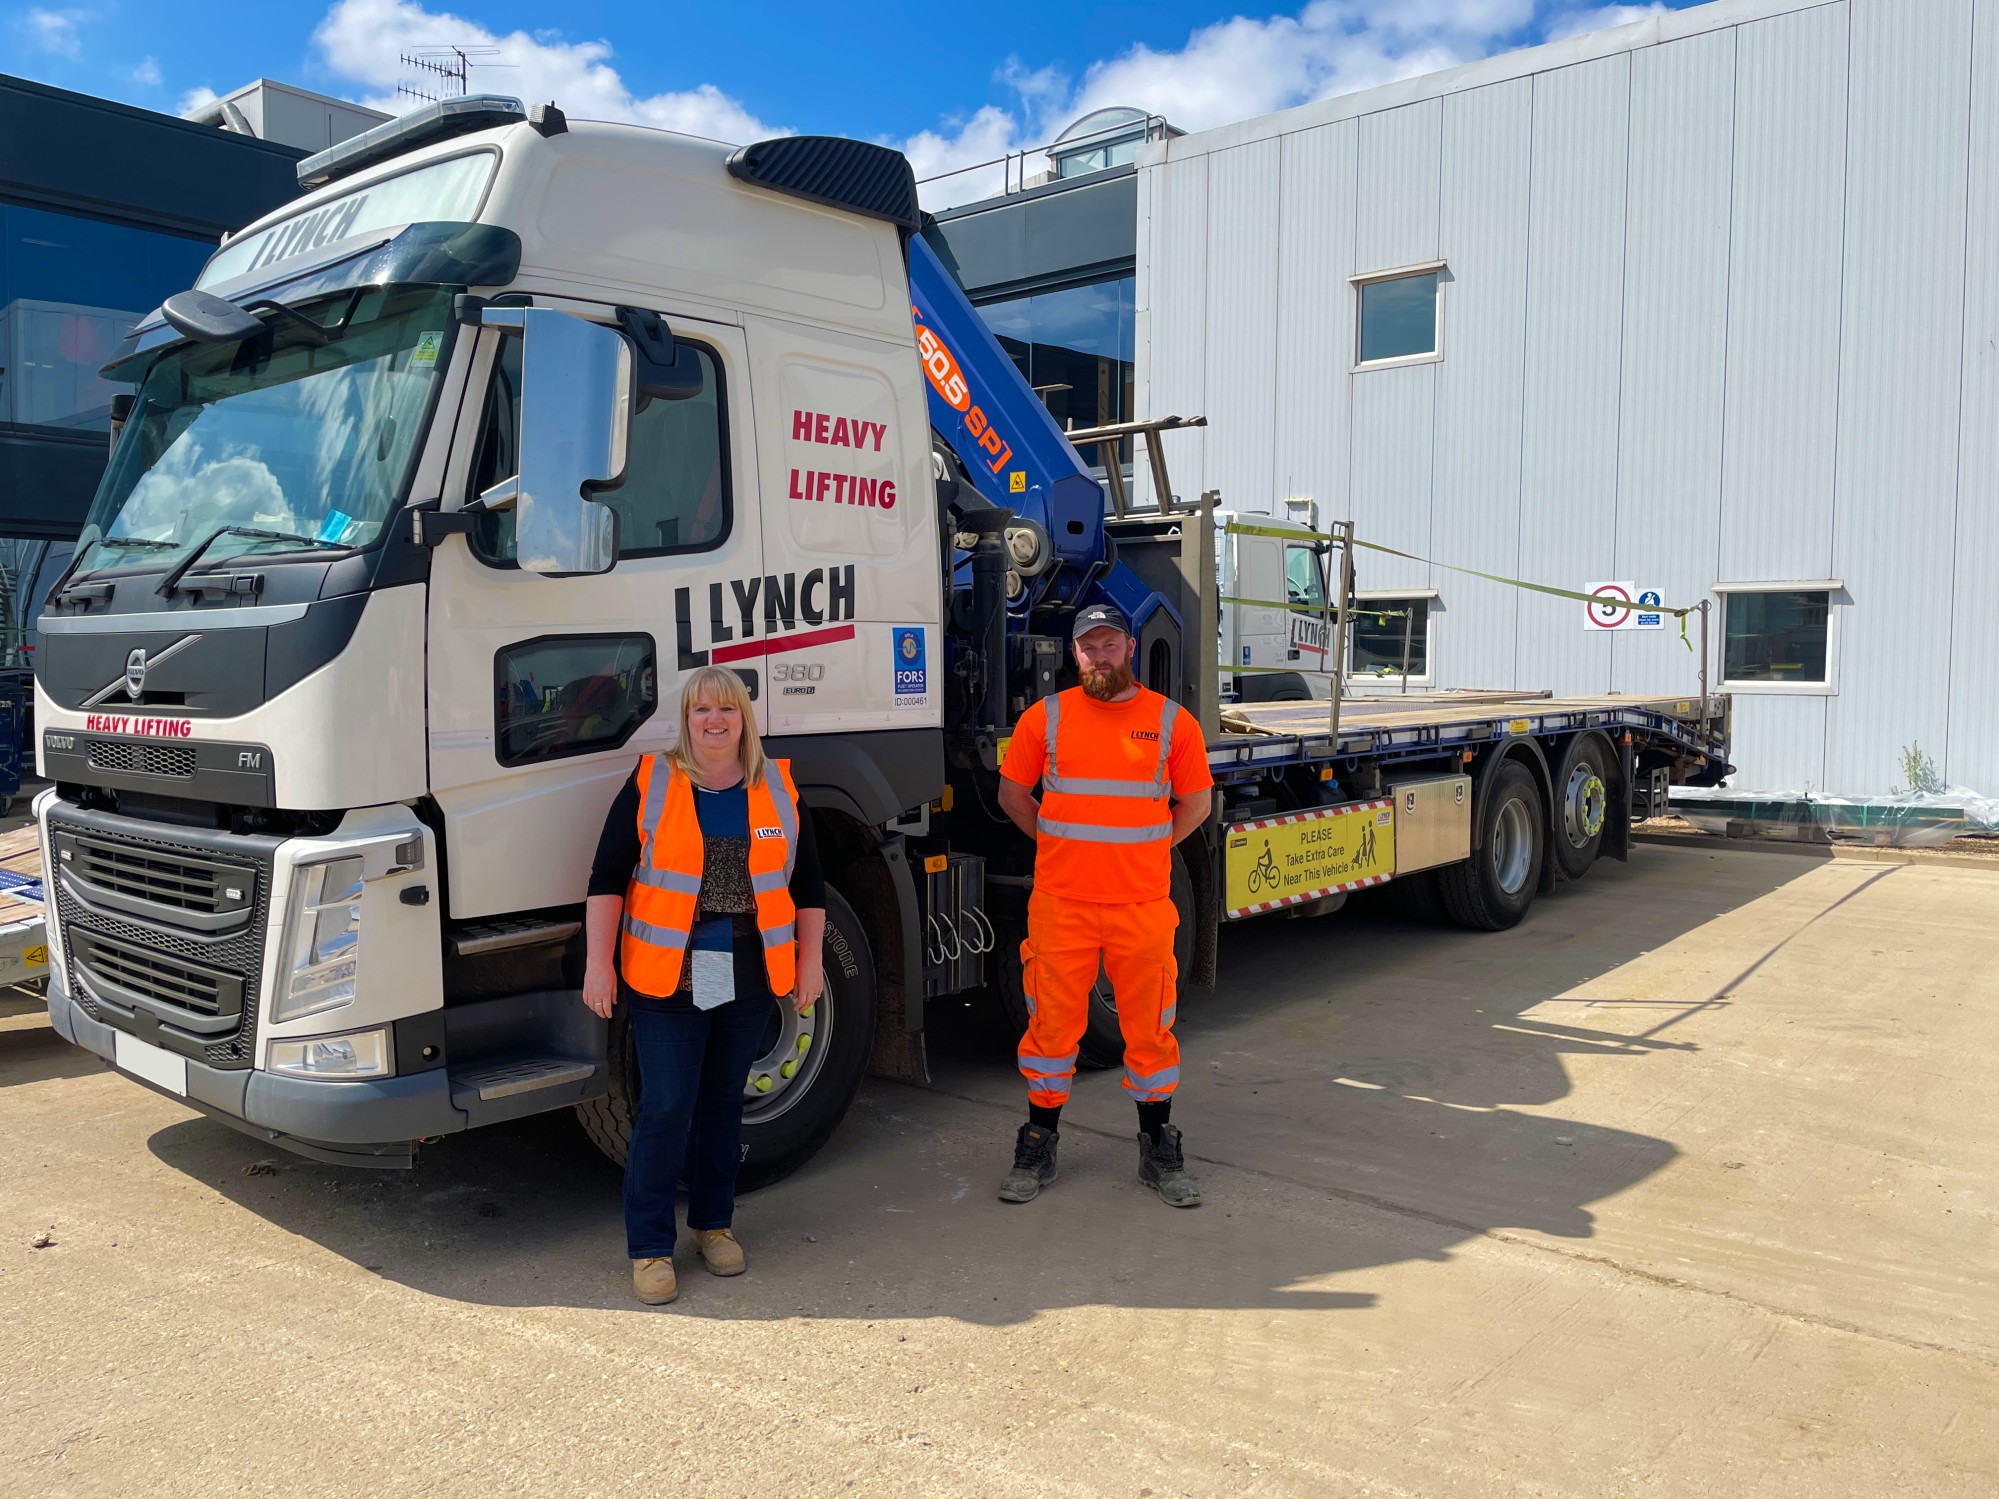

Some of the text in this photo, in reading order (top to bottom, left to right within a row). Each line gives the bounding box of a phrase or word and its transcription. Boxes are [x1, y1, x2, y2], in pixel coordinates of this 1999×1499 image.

[919, 329, 968, 405] 50.5
[792, 410, 888, 452] HEAVY
[789, 469, 896, 509] LIFTING
[773, 664, 825, 681] 380
[897, 671, 924, 683] FORS
[87, 714, 192, 737] HEAVY LIFTING
[45, 734, 75, 749] VOLVO
[238, 752, 261, 768] FM
[1301, 828, 1332, 845] PLEASE
[1285, 846, 1345, 866] Take Extra Care
[1283, 862, 1349, 887] Near This Vehicle
